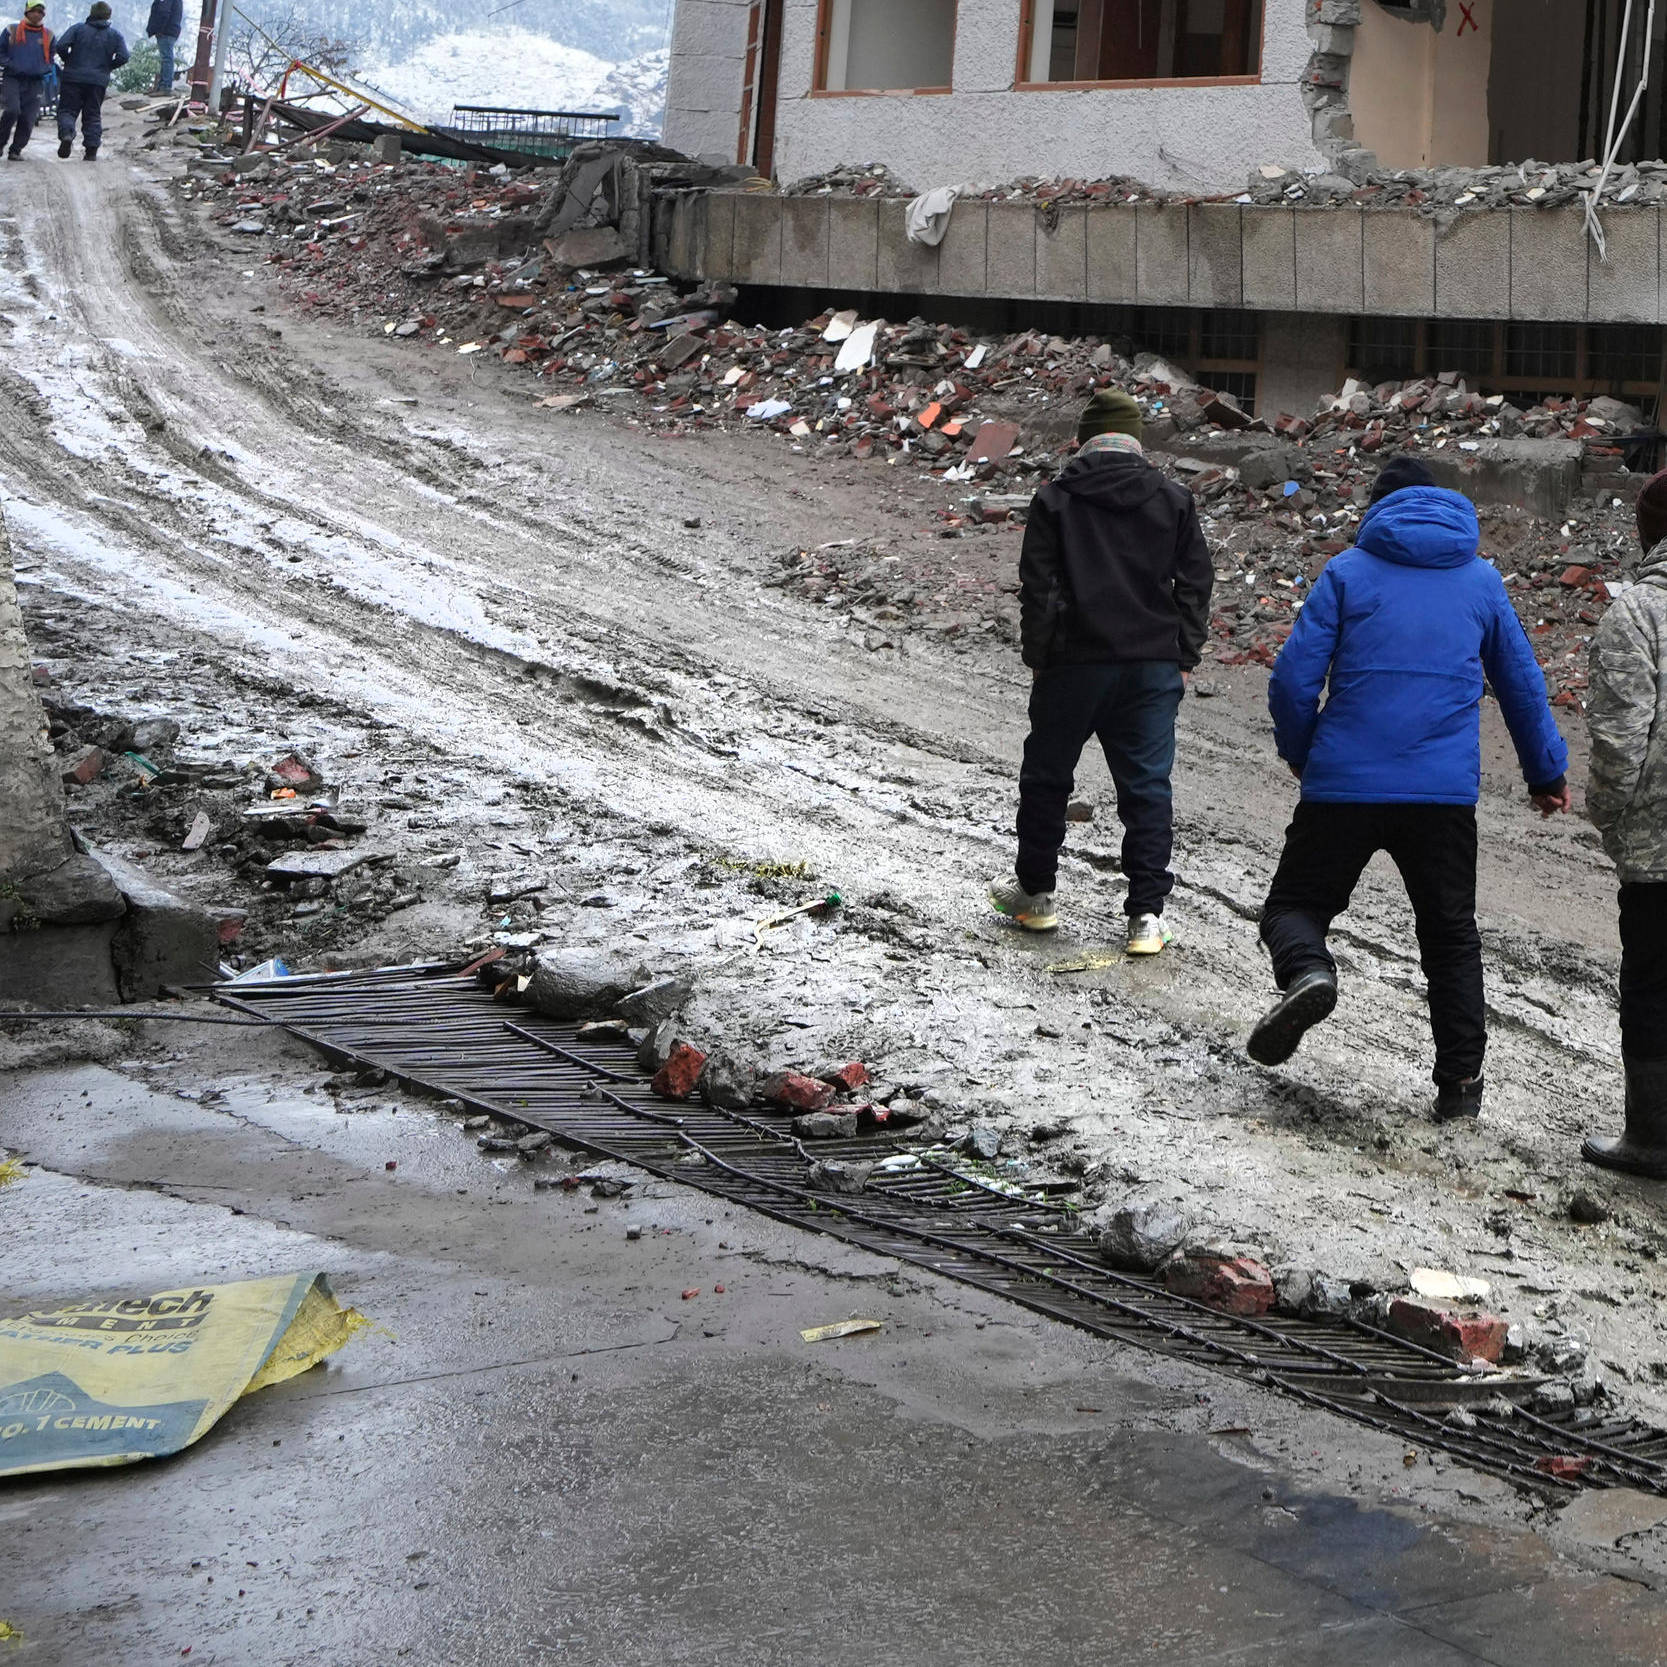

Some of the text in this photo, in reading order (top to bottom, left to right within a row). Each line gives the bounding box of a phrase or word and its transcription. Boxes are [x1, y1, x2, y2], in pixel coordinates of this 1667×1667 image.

[106, 1340, 194, 1356] PLUS
[0, 1414, 162, 1440] O. 1 CEMENT
